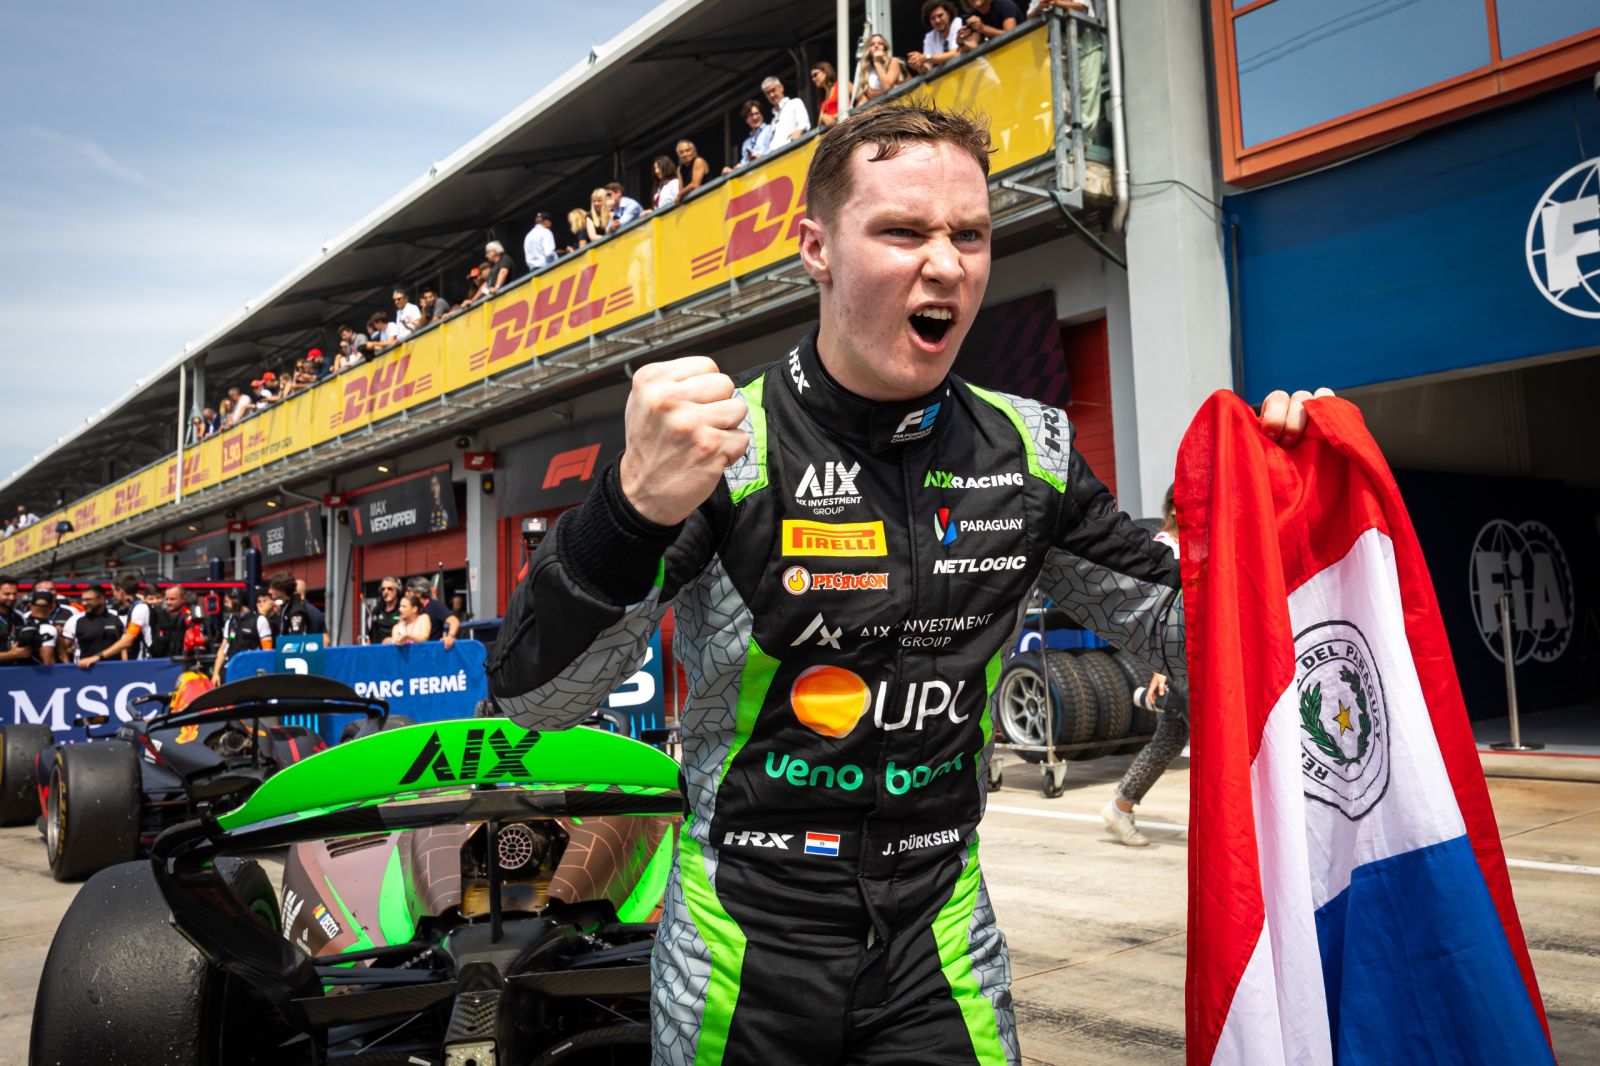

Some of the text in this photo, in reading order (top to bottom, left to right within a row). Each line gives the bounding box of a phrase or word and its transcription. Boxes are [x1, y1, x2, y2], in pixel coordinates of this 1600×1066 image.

[488, 263, 608, 364] DHL
[788, 345, 811, 395] HRX
[342, 353, 416, 424] DHL
[542, 443, 602, 490] F1
[795, 461, 861, 498] AIX
[369, 500, 387, 518] MAX
[808, 496, 862, 507] INVESTMENT
[813, 506, 844, 515] GROUP
[370, 508, 417, 533] VERSTAPPEN
[960, 518, 1023, 532] PARAGUAY
[792, 527, 876, 550] PIRELLI
[933, 556, 1027, 574] NETLOGIC
[811, 572, 889, 590] PECHUGON
[896, 613, 994, 633] NVESTMENT
[901, 636, 952, 648] GROUP
[1302, 645, 1340, 670] DEL
[354, 669, 467, 699] PARC FERMÉ
[8, 681, 158, 732] MSC
[874, 680, 969, 731] UPL
[398, 728, 542, 785] AIX
[723, 830, 795, 850] HRX
[882, 828, 960, 856] J. DÜRKSEN
